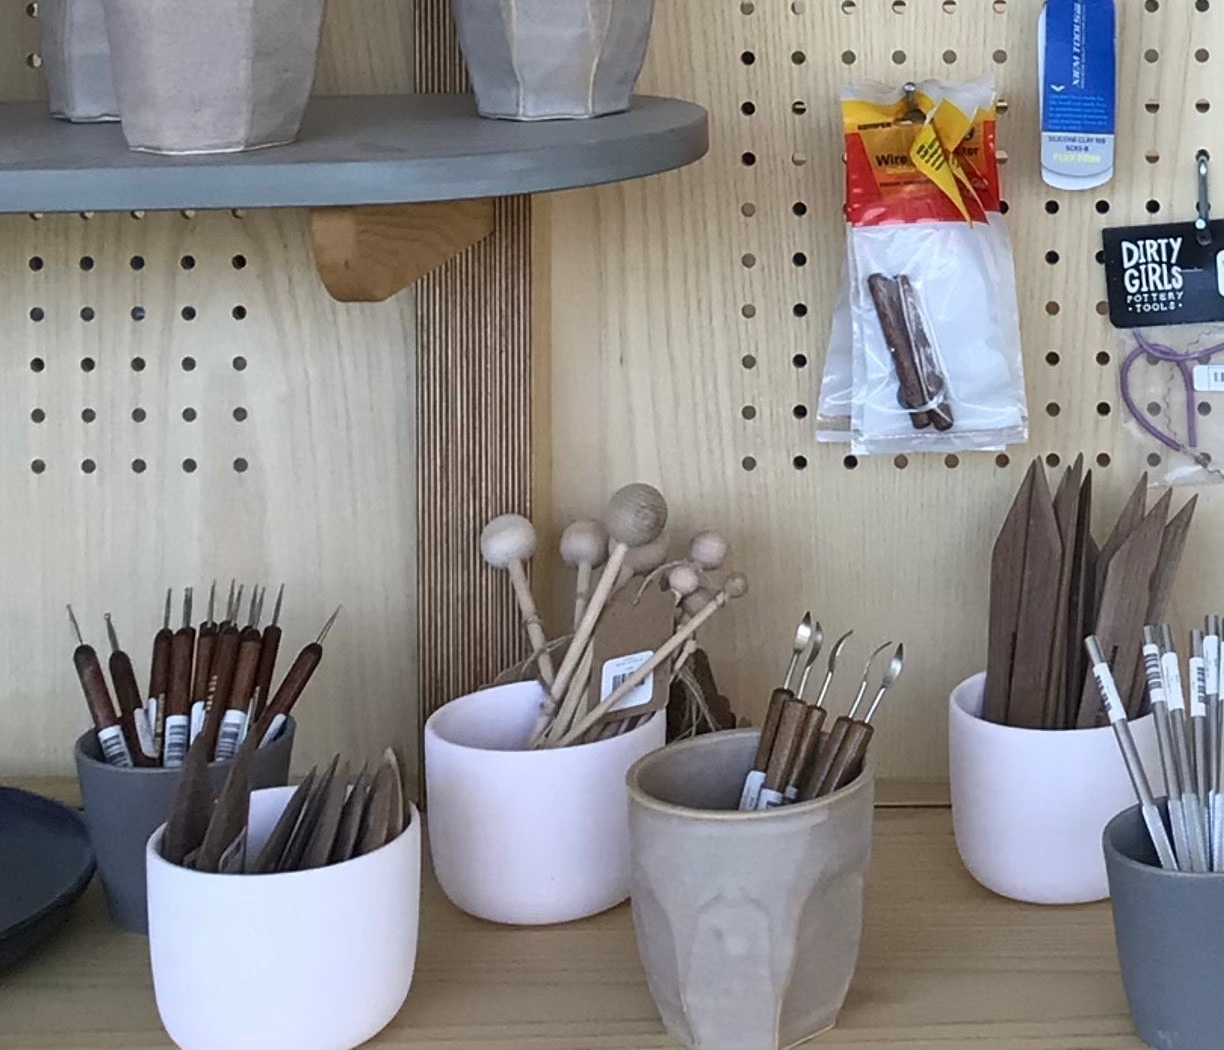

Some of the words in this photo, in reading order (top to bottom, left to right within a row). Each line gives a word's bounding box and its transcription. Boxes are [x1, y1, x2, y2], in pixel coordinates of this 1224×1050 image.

[875, 153, 907, 167] Wire
[1121, 237, 1183, 269] DIRTY
[1124, 263, 1184, 293] GIRLS
[1127, 291, 1184, 304] POTTERY
